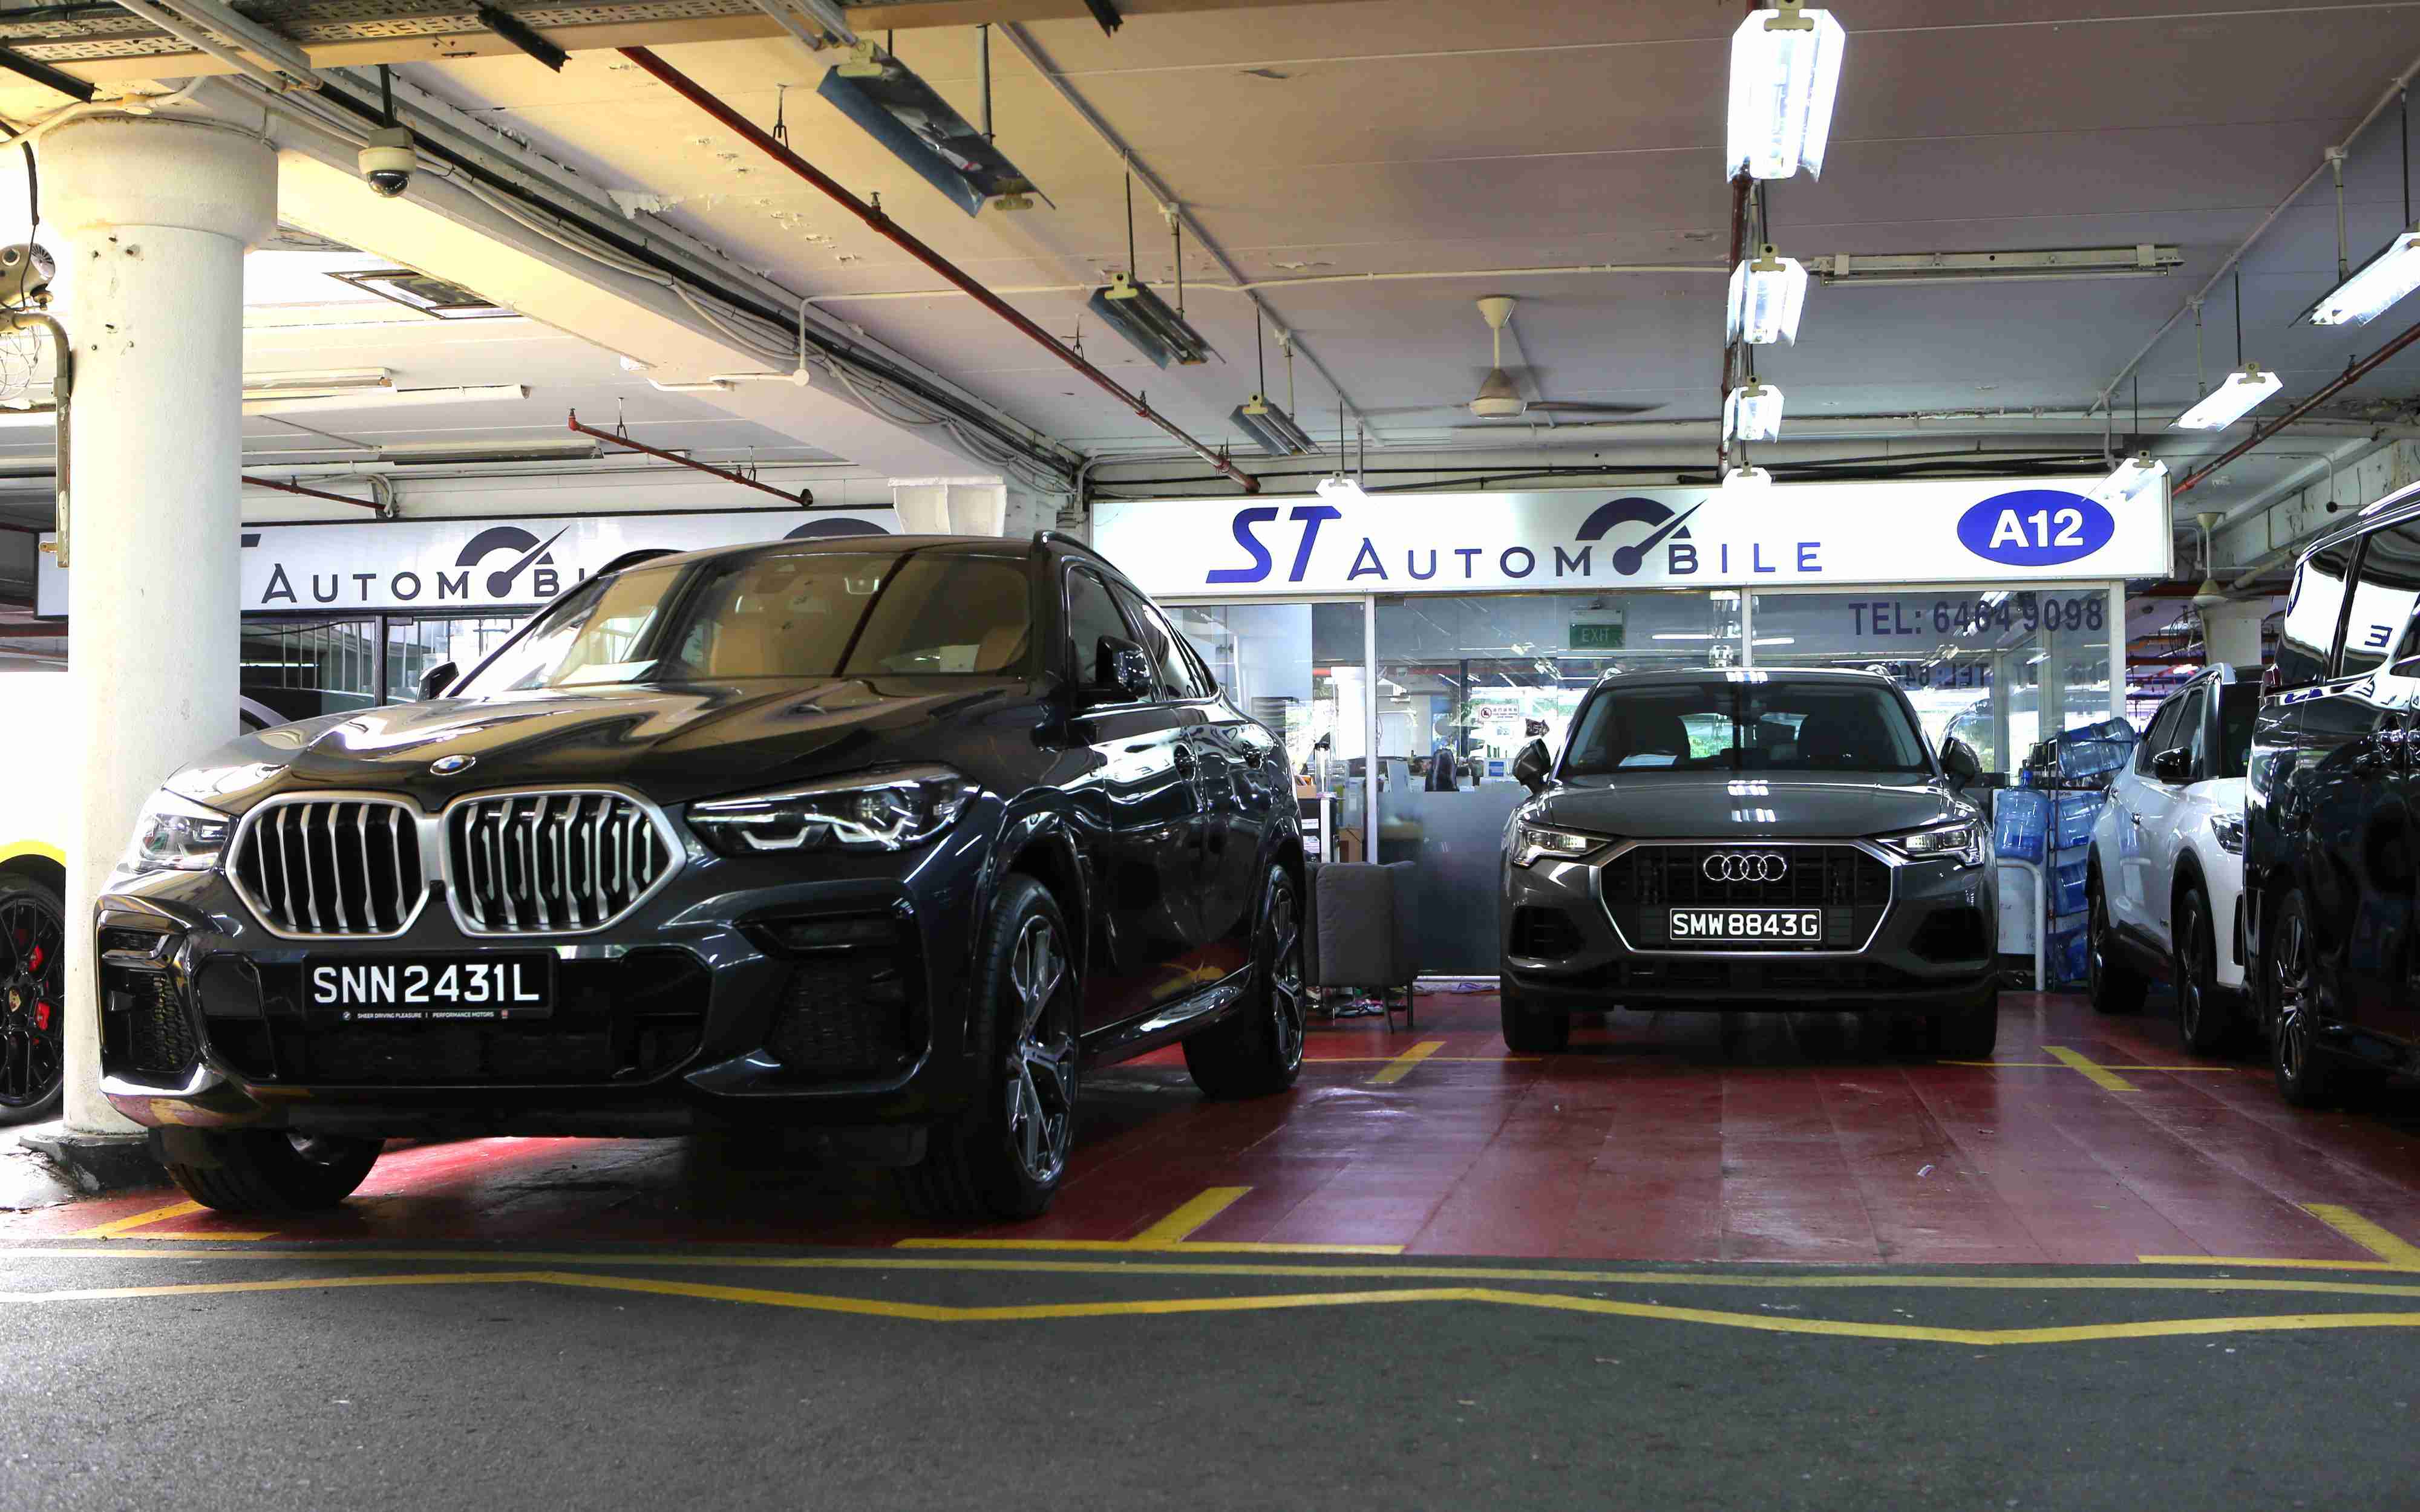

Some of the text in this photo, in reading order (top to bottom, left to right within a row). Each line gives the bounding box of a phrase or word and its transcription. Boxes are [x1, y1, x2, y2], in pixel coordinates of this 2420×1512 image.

[1206, 506, 1342, 584] ST
[1988, 508, 2084, 549] A12
[1848, 598, 2103, 636] TEL: 6464 9098
